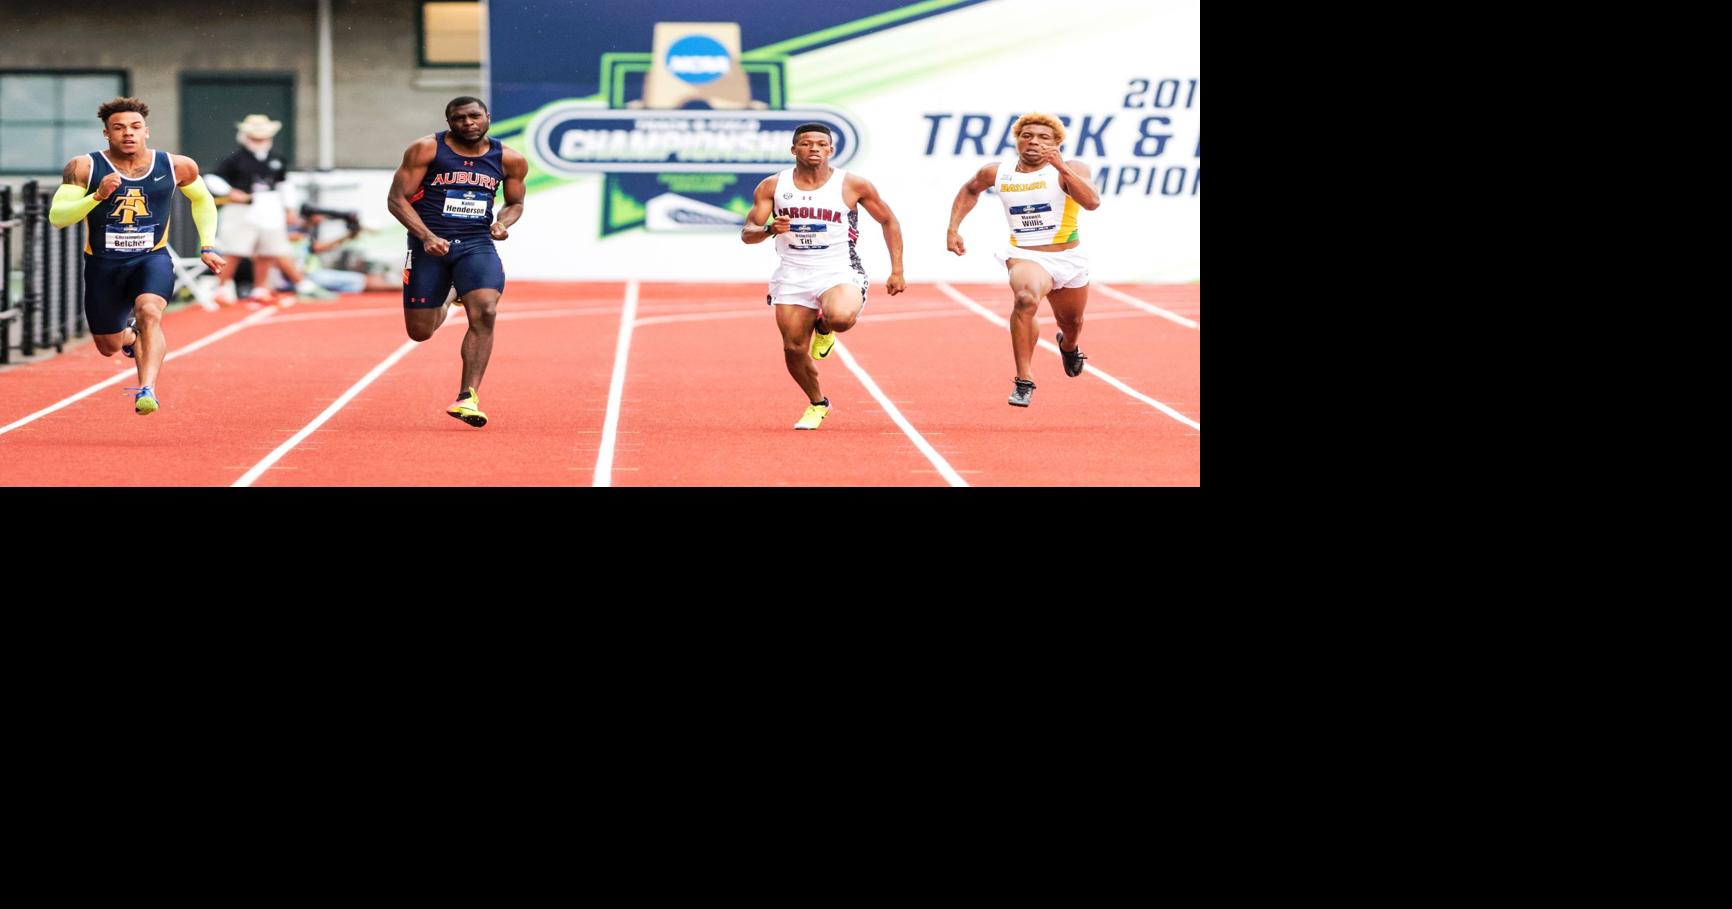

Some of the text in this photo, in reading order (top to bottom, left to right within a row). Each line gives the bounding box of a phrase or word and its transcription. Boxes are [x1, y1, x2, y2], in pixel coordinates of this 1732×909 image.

[922, 114, 1114, 157] TRAK
[1133, 116, 1173, 157] &
[431, 171, 498, 191] AUBURN
[446, 204, 484, 214] Henderson
[1022, 219, 1043, 227] Willis
[114, 240, 146, 248] Belcher
